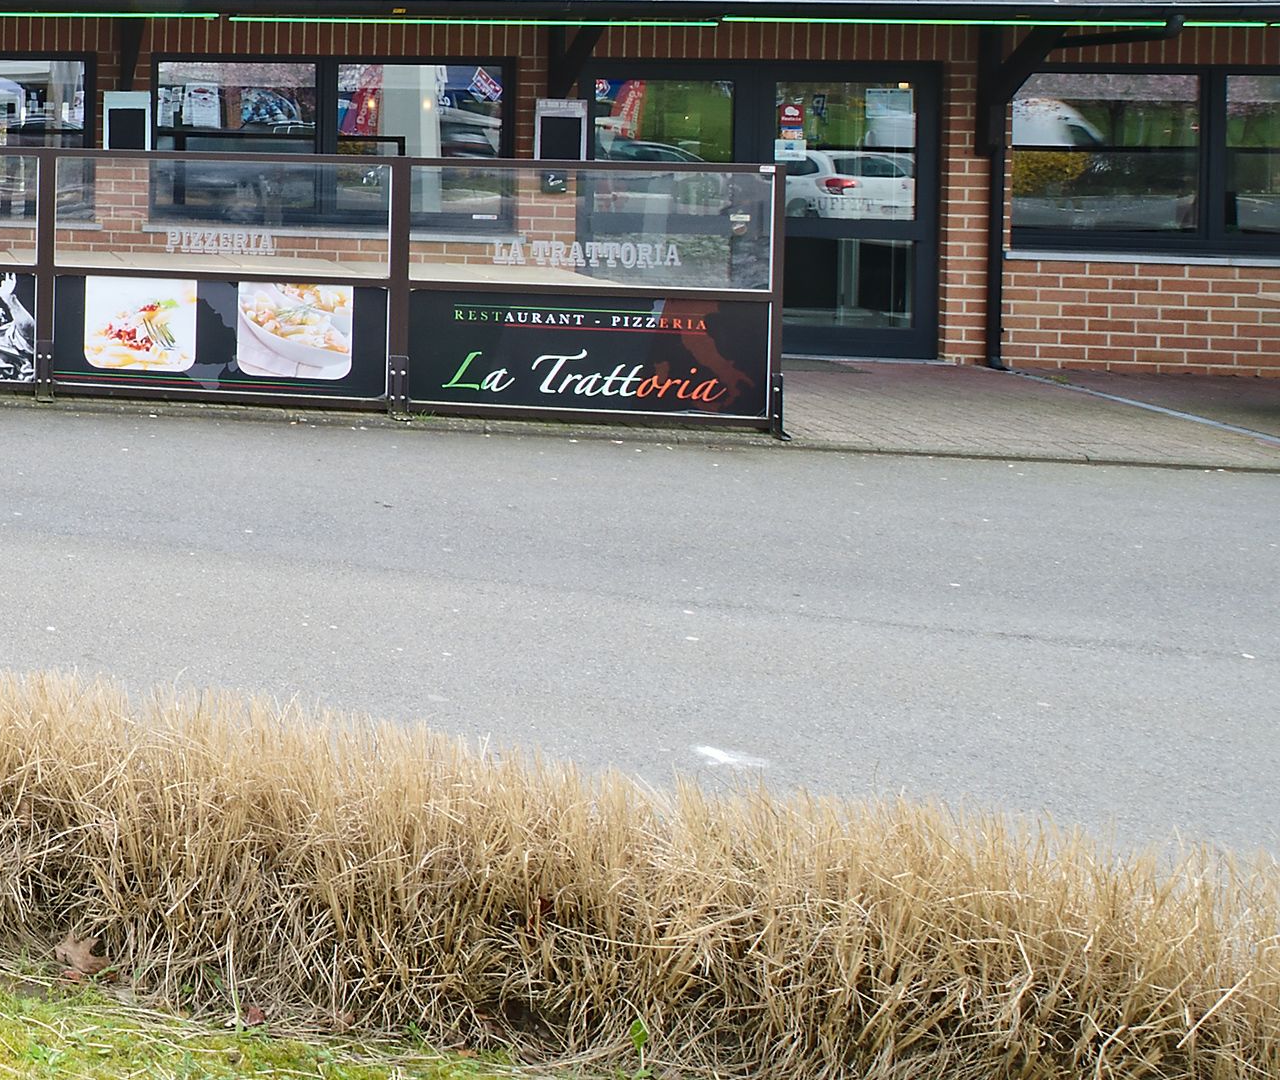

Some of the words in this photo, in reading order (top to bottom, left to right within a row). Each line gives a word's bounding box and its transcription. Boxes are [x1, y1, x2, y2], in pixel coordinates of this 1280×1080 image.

[165, 229, 276, 256] PIZZERIA
[492, 240, 526, 265] LA
[531, 240, 682, 268] TRATTORIA
[454, 309, 585, 326] RESTAURANT
[611, 315, 707, 331] PIZZERIA
[442, 351, 515, 393] La
[531, 349, 727, 402] Trattoria
